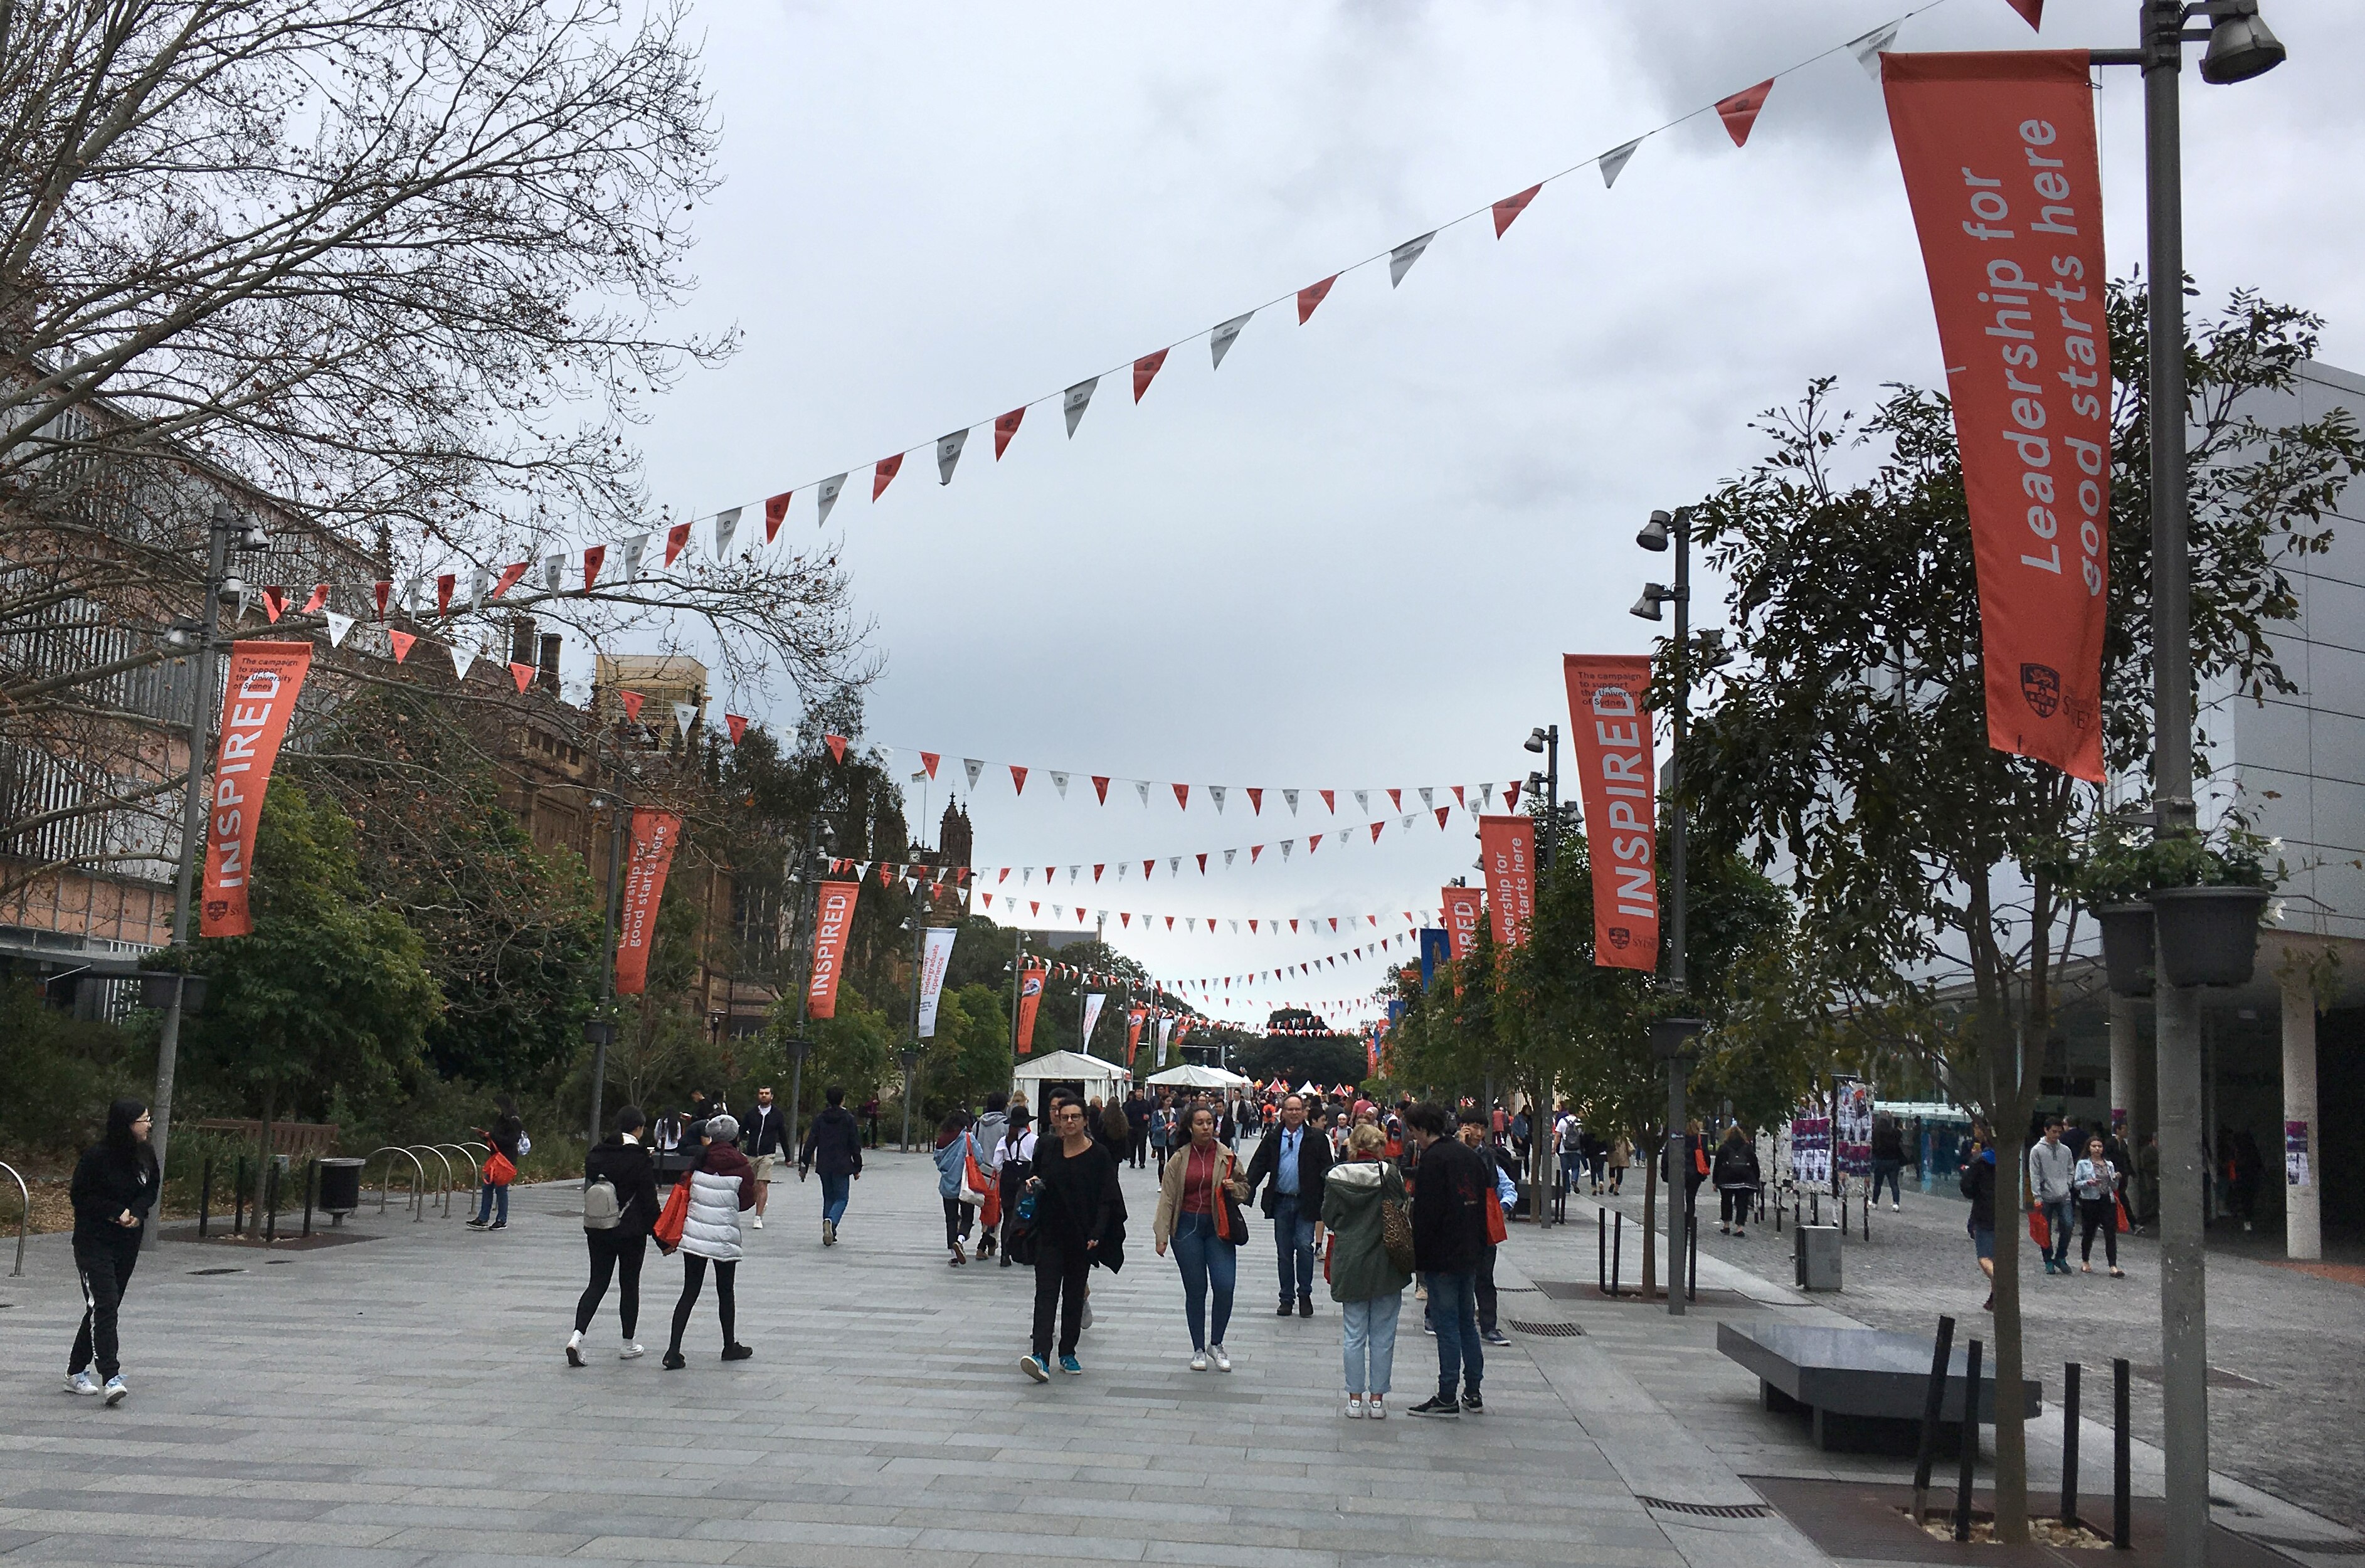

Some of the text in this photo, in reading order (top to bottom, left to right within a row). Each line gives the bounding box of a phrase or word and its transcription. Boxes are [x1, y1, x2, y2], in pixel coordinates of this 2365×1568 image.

[1962, 167, 2061, 575] Leadership for
[2019, 119, 2102, 596] good starts here
[243, 682, 272, 692] Sydney
[251, 675, 292, 683] University
[1592, 682, 1628, 690] support
[1594, 698, 1627, 707] Sydney
[1597, 672, 1641, 681] campaign
[218, 672, 280, 888] INSPIRED
[1592, 686, 1654, 919] INSPIRED
[1512, 837, 1525, 872] here
[619, 866, 642, 949] Leadership
[630, 826, 667, 947] good starts here
[1495, 852, 1518, 952] adership for
[812, 895, 847, 996] INSPIRED
[1454, 902, 1478, 960] IRED
[923, 944, 940, 996] Undergraduate
[929, 956, 944, 995] Experience
